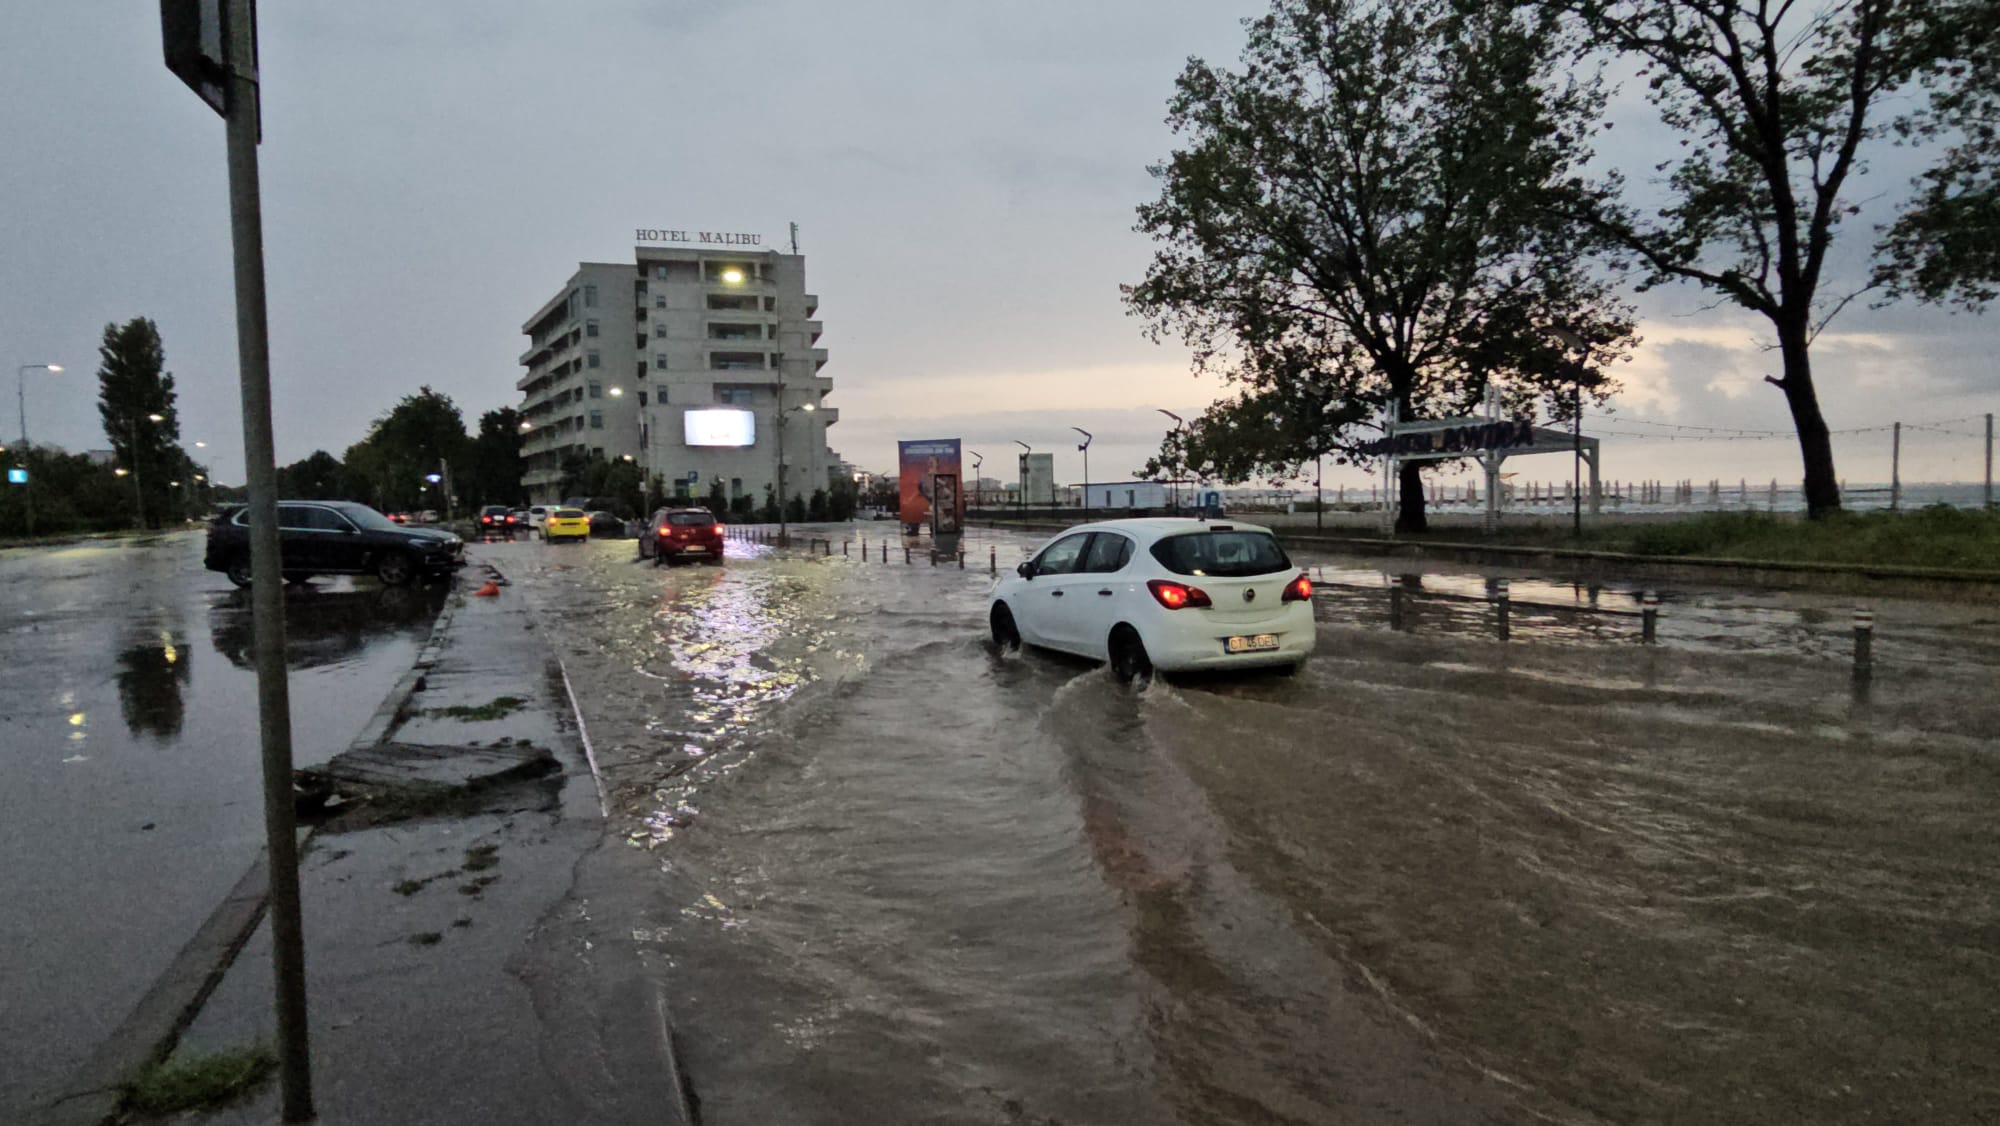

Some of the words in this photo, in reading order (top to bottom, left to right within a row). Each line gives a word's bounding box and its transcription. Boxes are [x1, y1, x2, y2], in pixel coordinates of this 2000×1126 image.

[636, 229, 690, 242] HOTEL
[699, 231, 761, 245] MALIBU
[1230, 638, 1244, 650] CT
